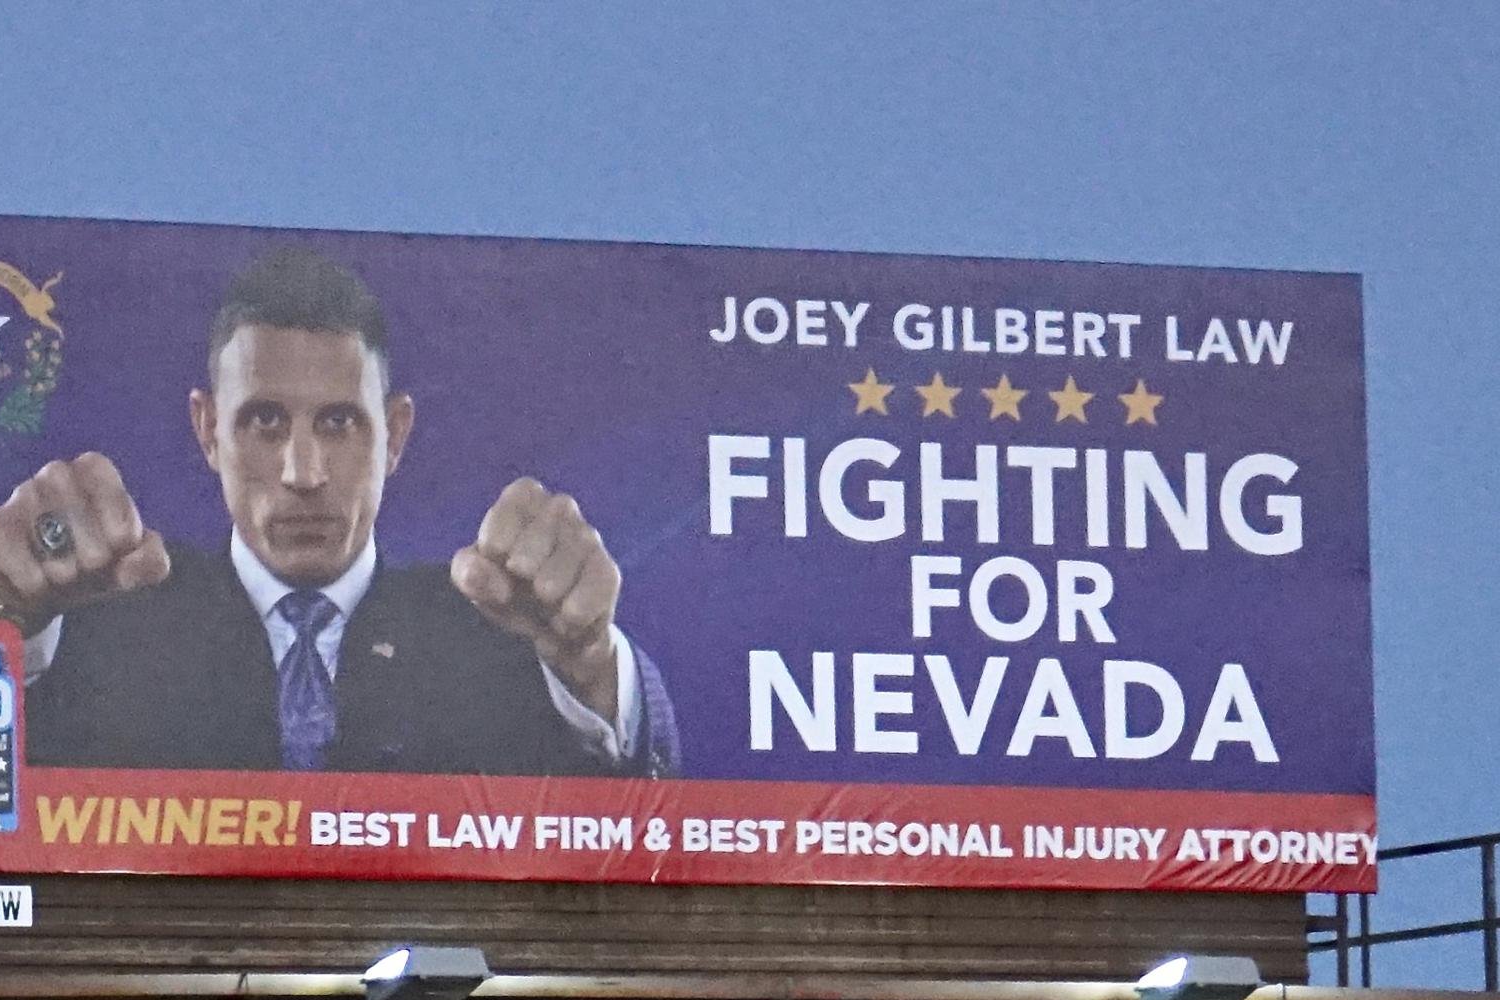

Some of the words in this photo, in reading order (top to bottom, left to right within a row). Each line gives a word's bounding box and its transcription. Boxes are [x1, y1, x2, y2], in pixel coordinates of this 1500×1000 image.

[709, 296, 870, 348] JOEY
[893, 305, 1141, 358] GILBERT
[1166, 315, 1294, 366] LAW
[706, 434, 1303, 556] FIGHTING
[910, 555, 1117, 644] FOR
[748, 650, 1280, 764] NEVADA
[36, 796, 302, 847] WINNER!
[309, 810, 416, 848] BEST
[427, 813, 522, 850] LAW
[533, 816, 634, 852] FIRM
[643, 818, 671, 852] &
[682, 818, 786, 854] BEST
[795, 820, 1014, 859] PERSONAL
[1023, 824, 1165, 862] INJURY
[1175, 829, 1379, 866] ATTORNEY
